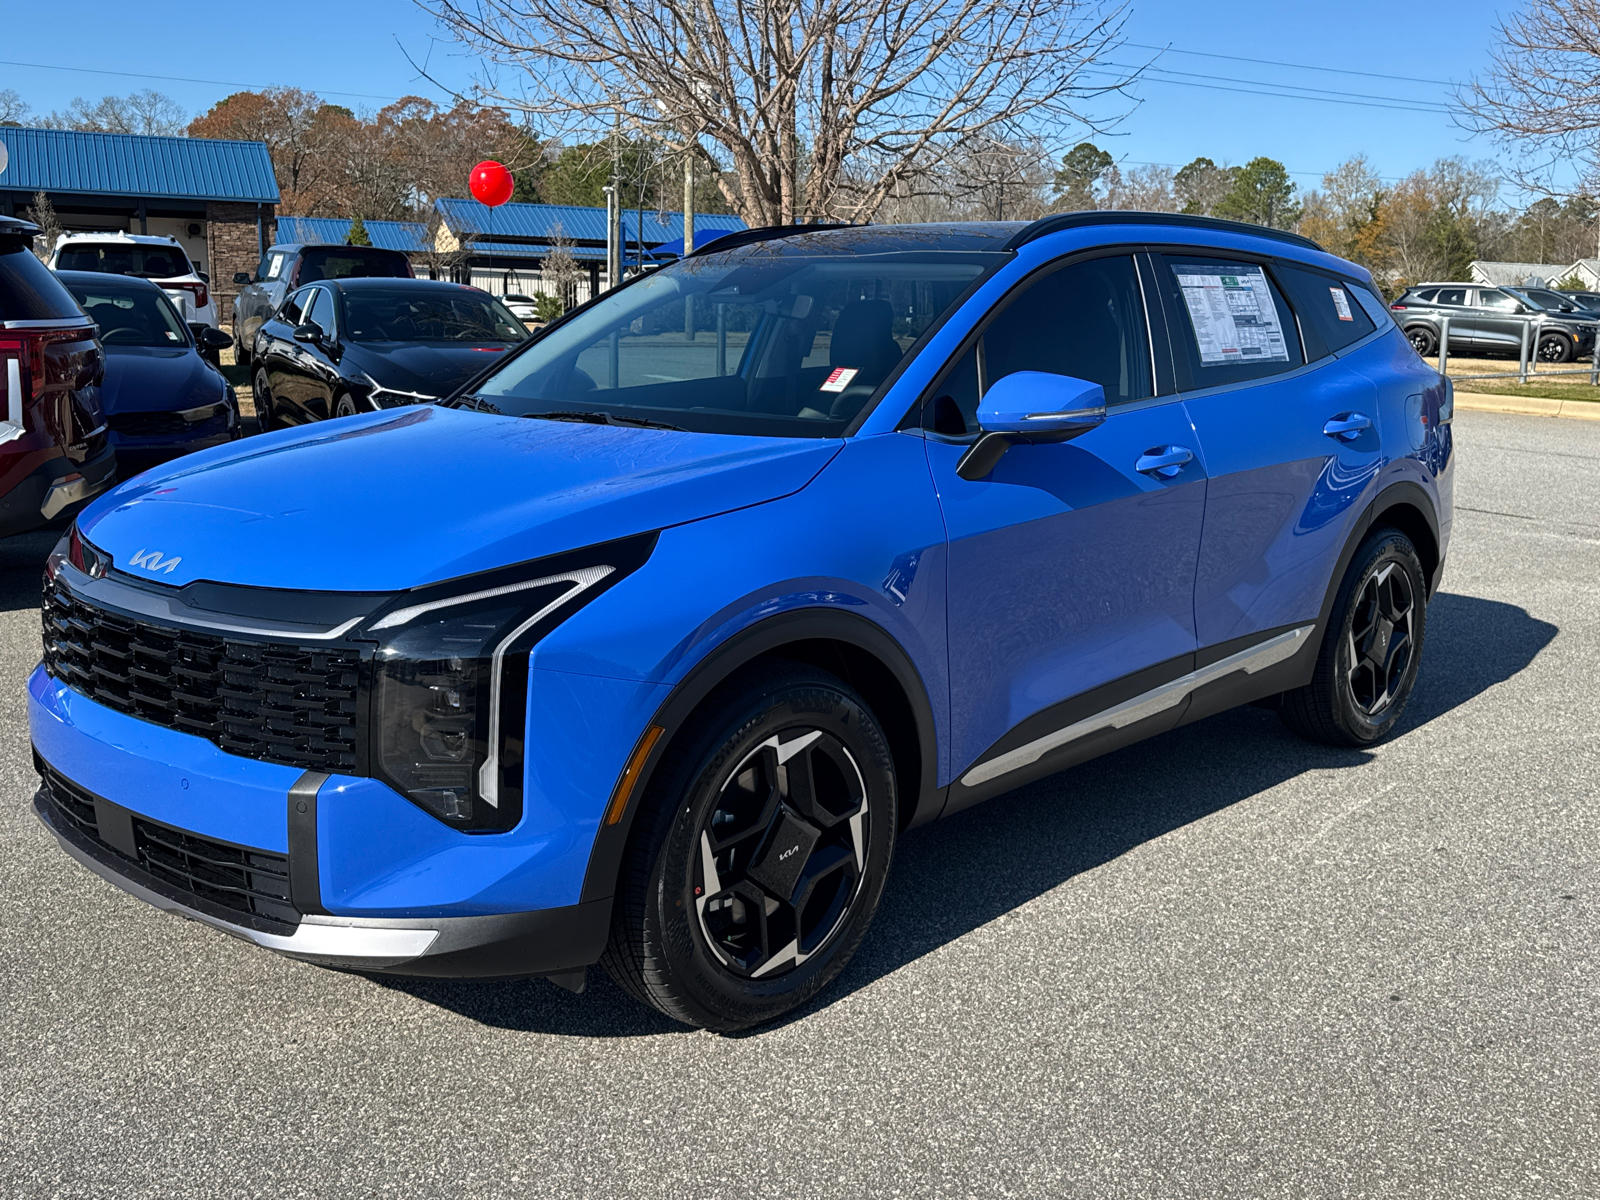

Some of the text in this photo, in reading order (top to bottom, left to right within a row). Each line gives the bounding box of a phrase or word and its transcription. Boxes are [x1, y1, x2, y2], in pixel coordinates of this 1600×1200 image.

[129, 548, 182, 574] KIA
[779, 845, 799, 861] KIA
[739, 1002, 776, 1015] 235/60
